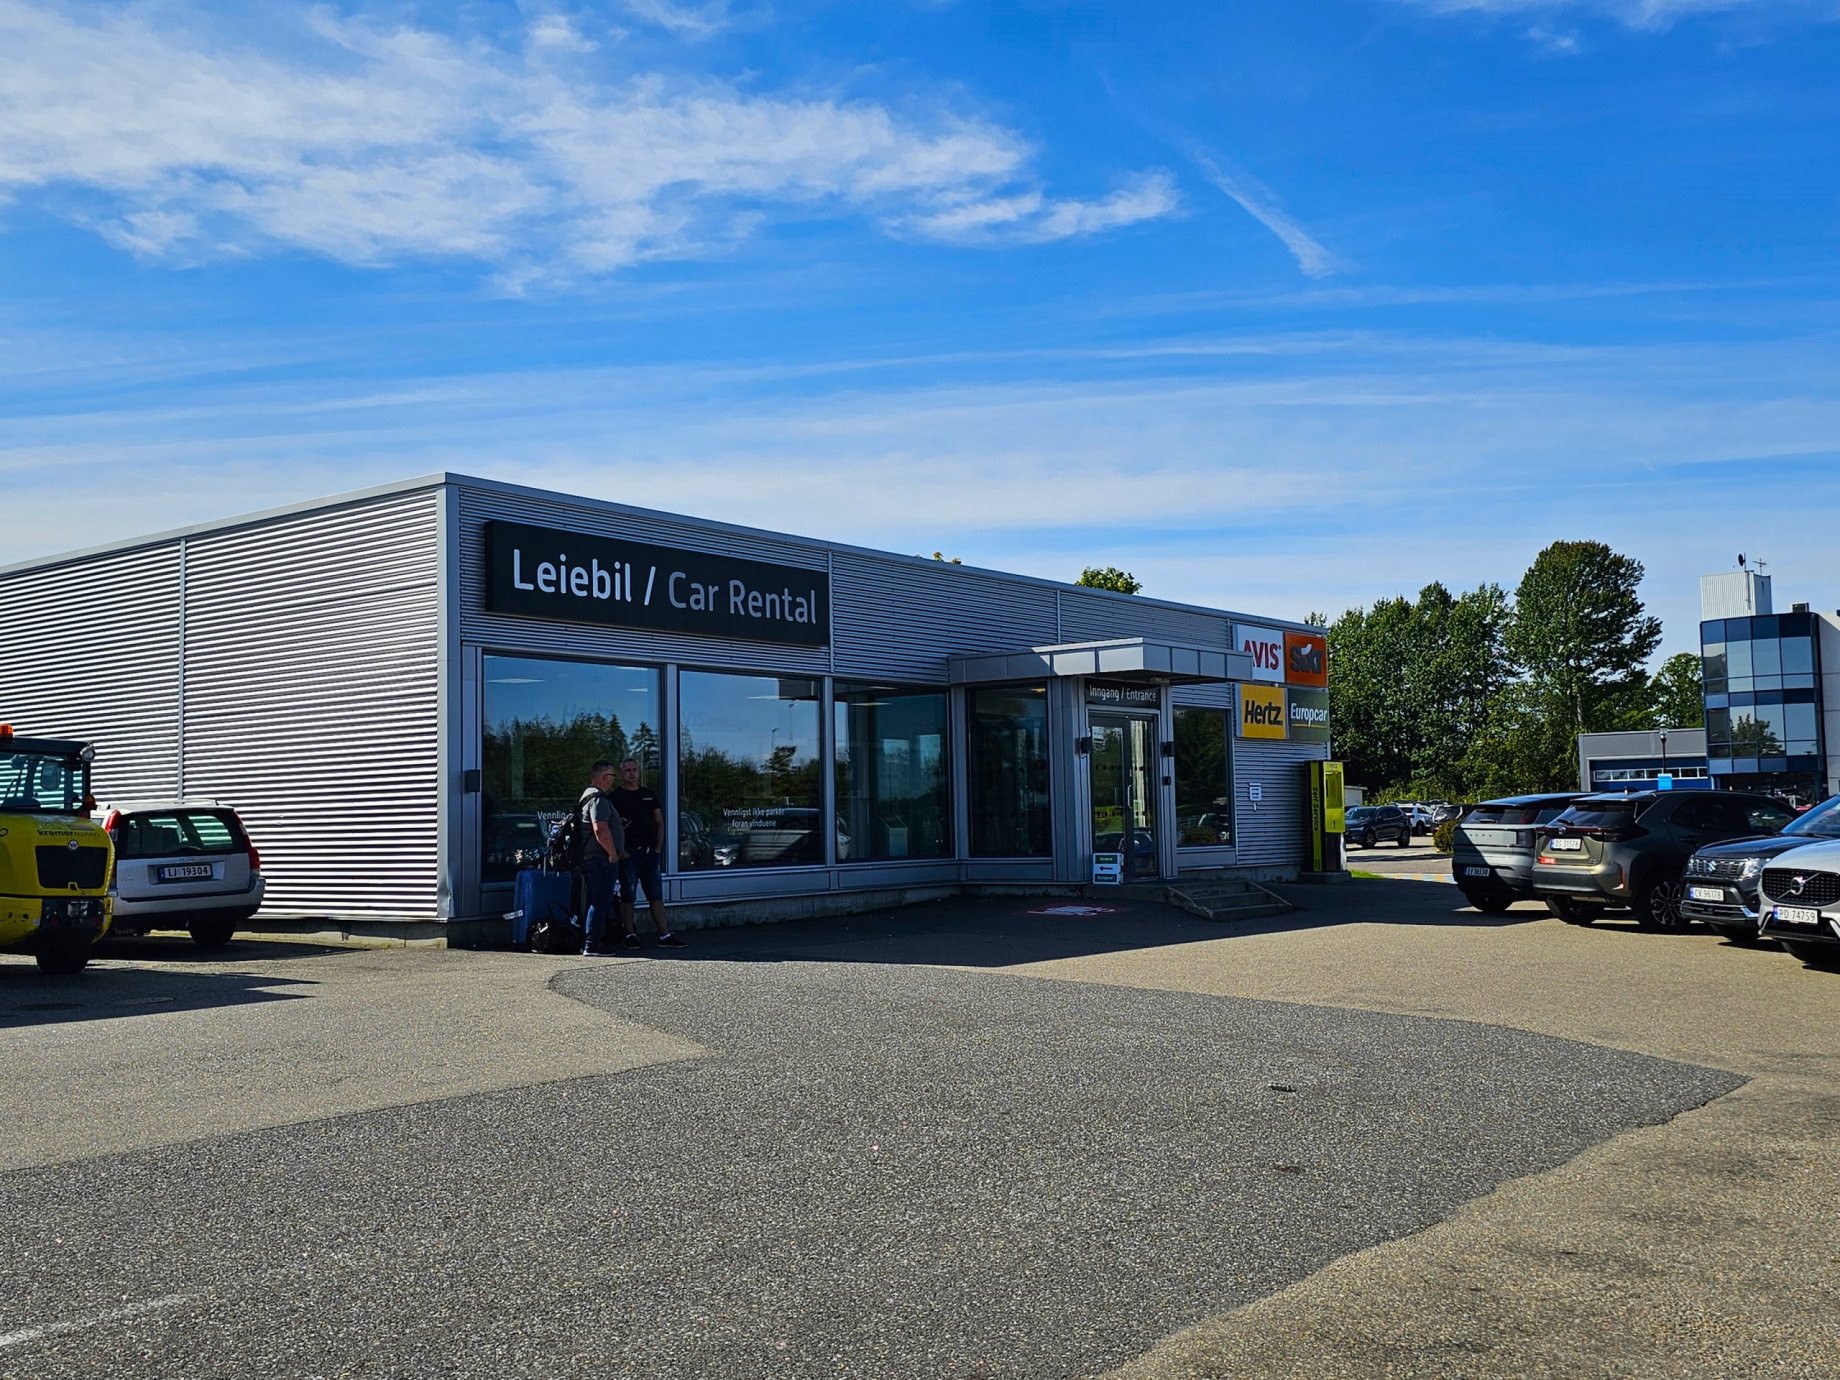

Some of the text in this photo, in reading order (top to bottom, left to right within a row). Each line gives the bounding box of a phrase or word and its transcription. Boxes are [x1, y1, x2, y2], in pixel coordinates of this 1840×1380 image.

[513, 548, 816, 625] Leiebil / Car Rental
[1089, 684, 1120, 702] Inngang
[1126, 687, 1157, 702] Entrance
[1244, 700, 1283, 726] Hertz
[1290, 702, 1328, 728] Europcar
[723, 808, 751, 818] Vennligst
[752, 808, 765, 816] ikke
[182, 866, 209, 876] 19304
[1779, 908, 1816, 922] PD 74759
